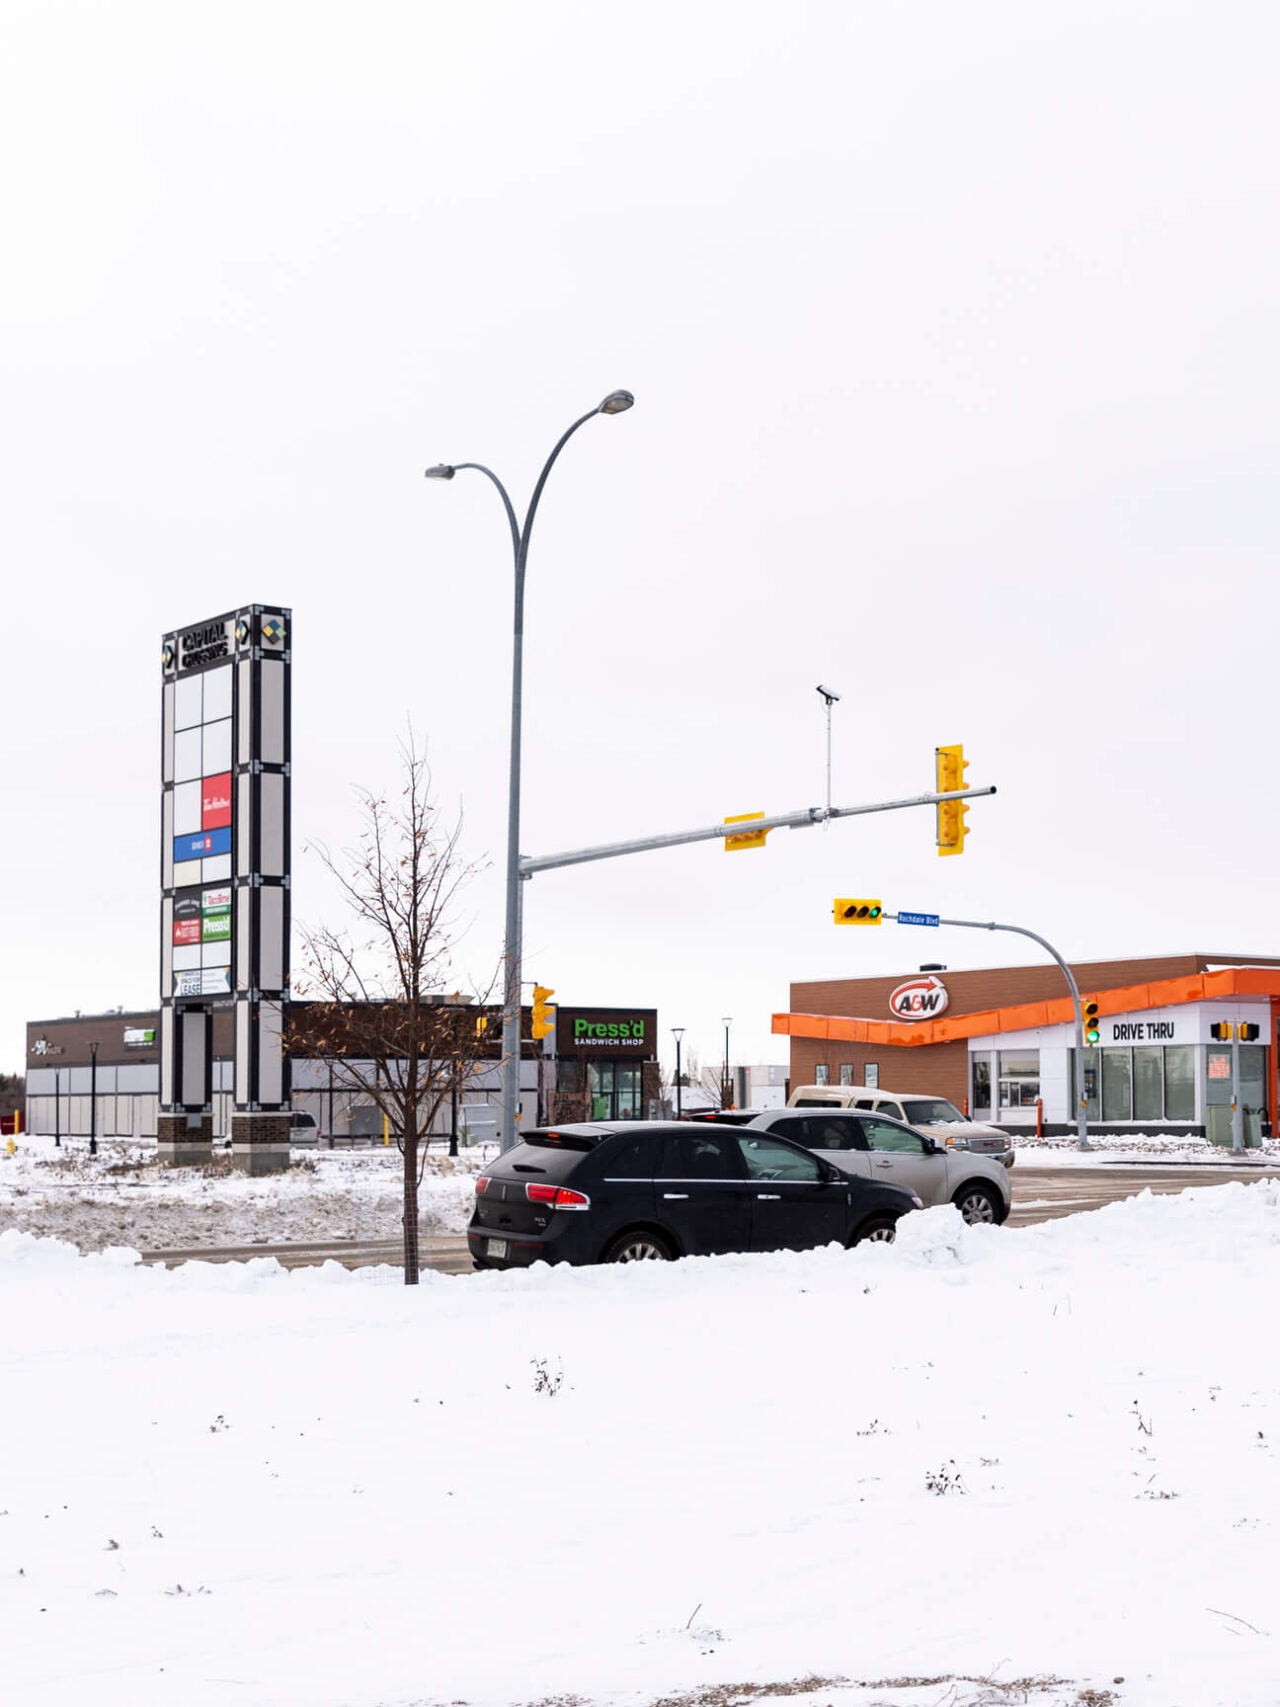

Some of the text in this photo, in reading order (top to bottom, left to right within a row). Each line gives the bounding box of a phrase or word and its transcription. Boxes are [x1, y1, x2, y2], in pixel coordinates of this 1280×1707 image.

[182, 621, 228, 650] CAPITAL
[926, 916, 939, 925] Blvd
[898, 994, 940, 1012] A&W
[574, 1019, 645, 1037] Press'd
[1113, 1021, 1175, 1041] DRIVE THRU
[574, 1038, 644, 1046] SANDWICH SHOP
